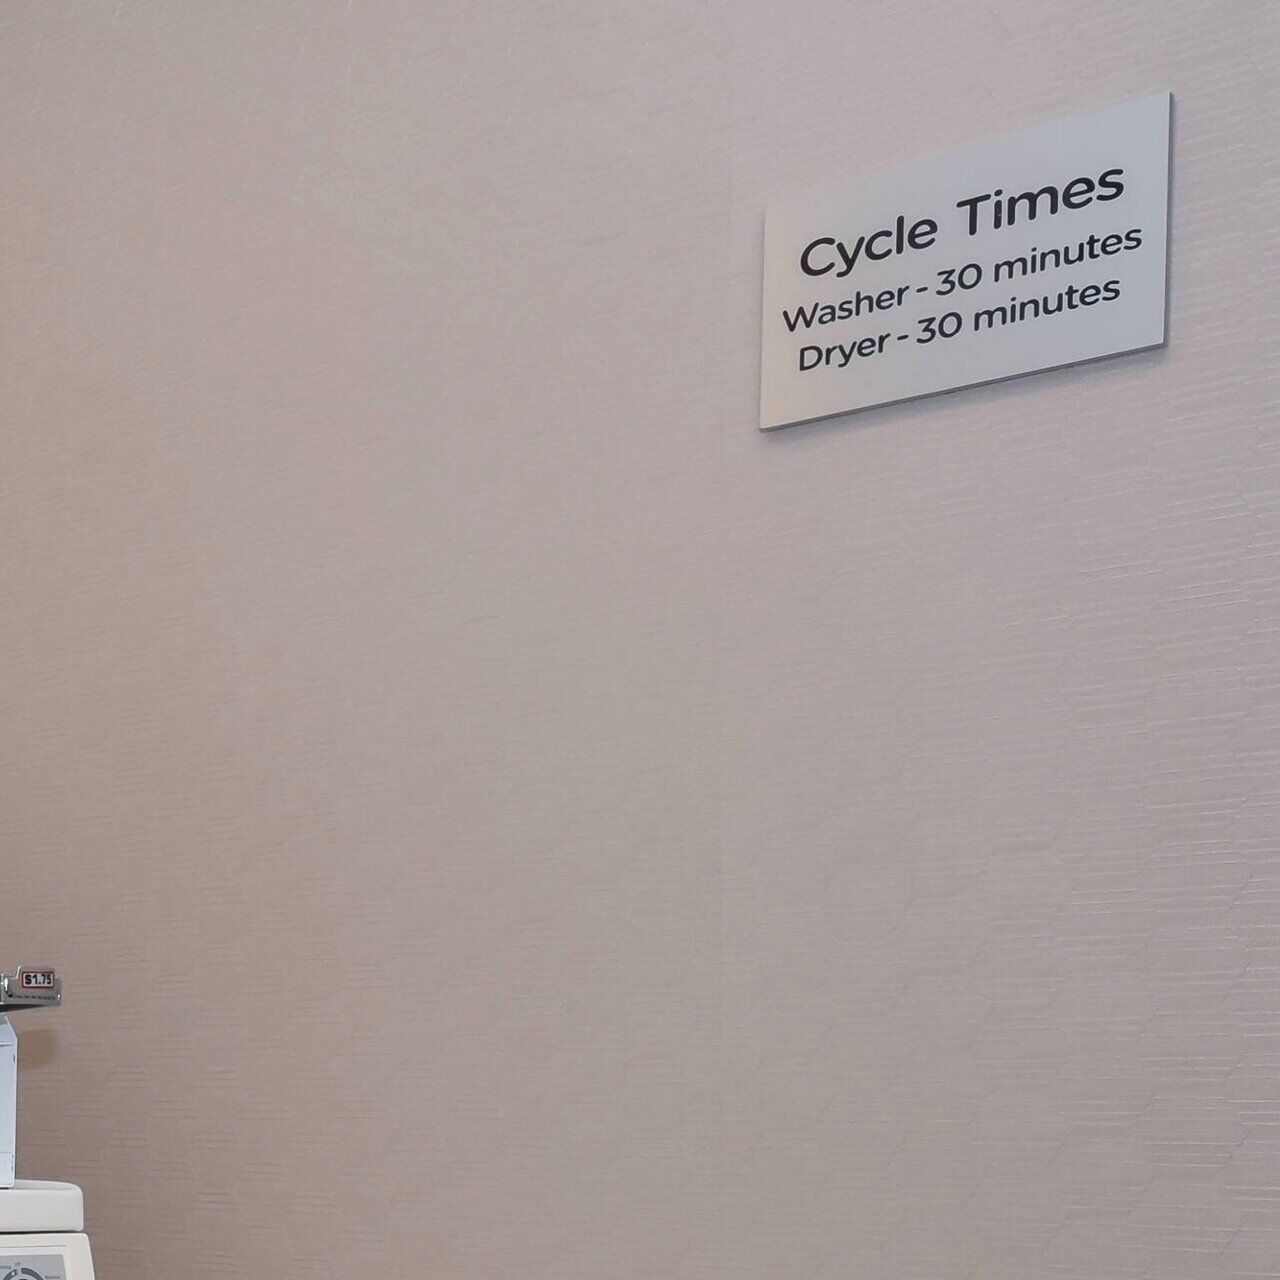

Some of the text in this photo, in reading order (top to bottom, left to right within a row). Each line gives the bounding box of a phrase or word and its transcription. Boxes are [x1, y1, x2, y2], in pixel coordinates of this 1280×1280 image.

[800, 168, 1125, 278] Cycle Times
[782, 285, 910, 332] Washer
[936, 262, 982, 296] 30
[993, 228, 1143, 282] minutes
[799, 331, 891, 372] Dryer
[916, 311, 963, 344] 30
[974, 279, 1121, 331] minutes
